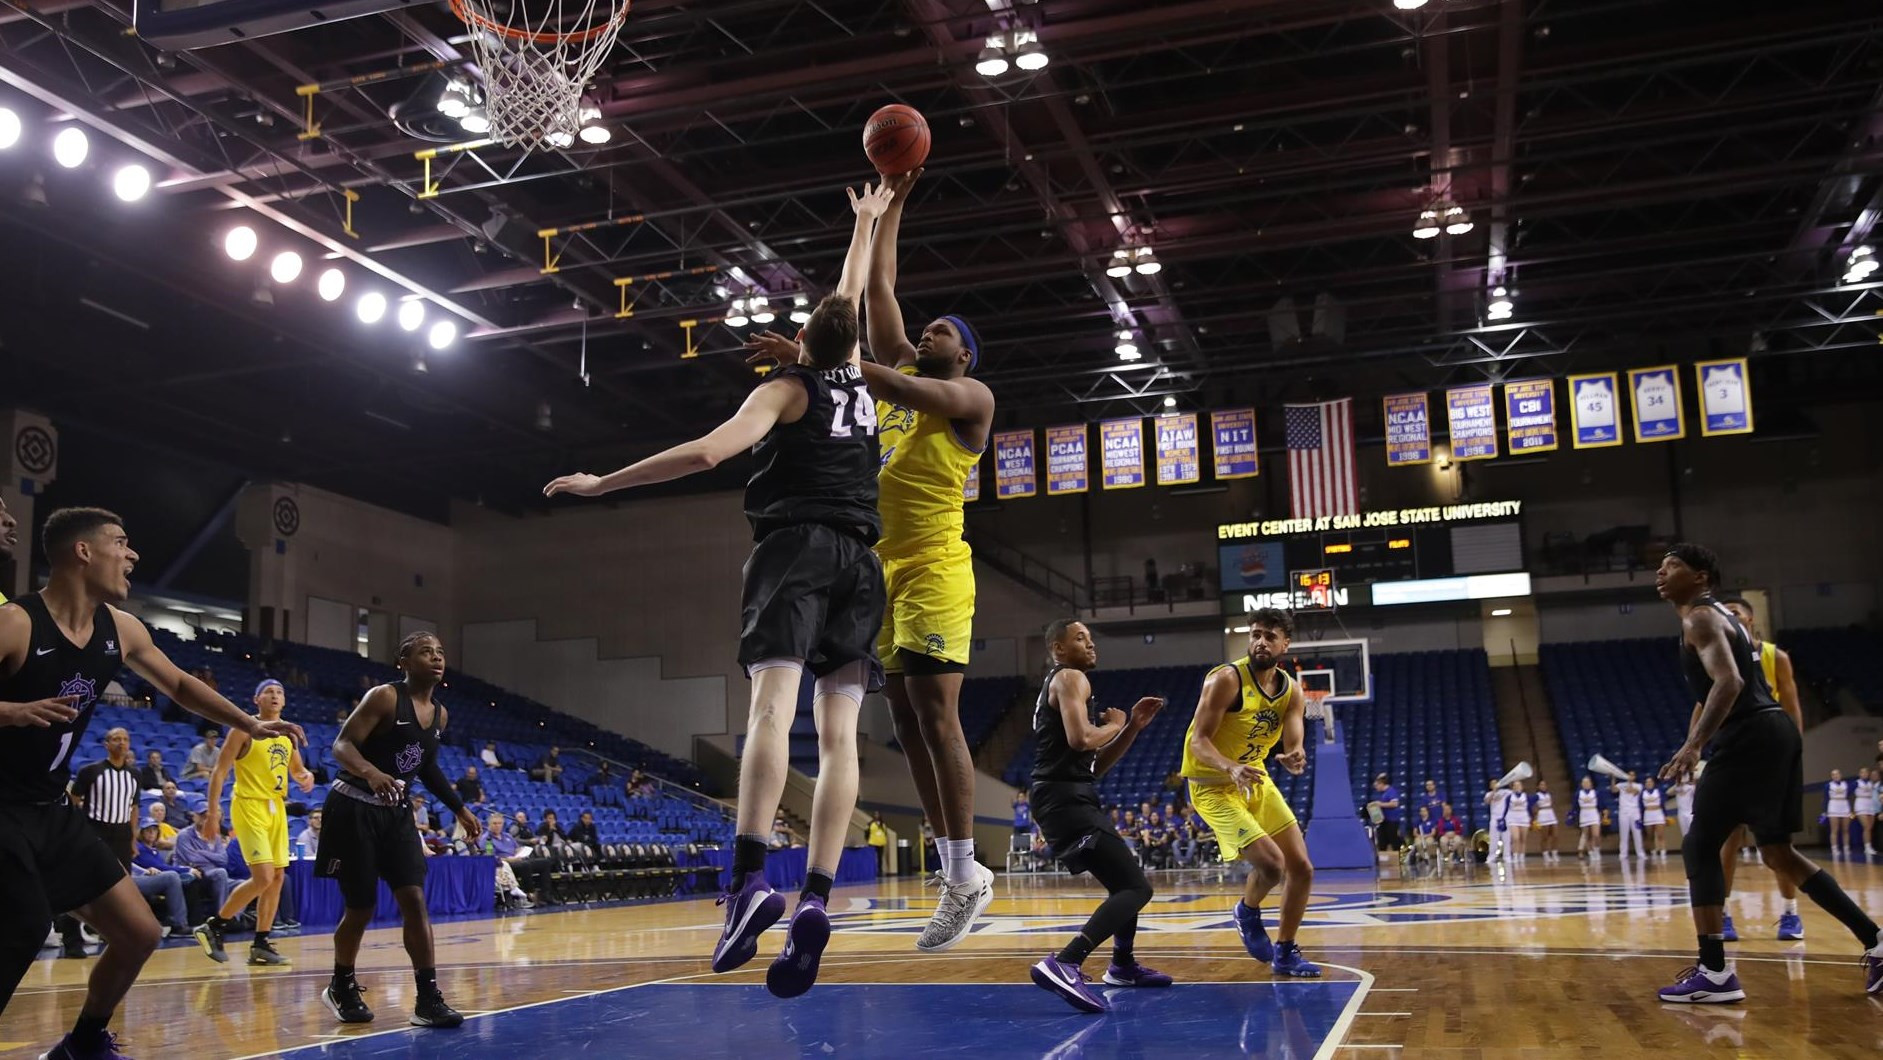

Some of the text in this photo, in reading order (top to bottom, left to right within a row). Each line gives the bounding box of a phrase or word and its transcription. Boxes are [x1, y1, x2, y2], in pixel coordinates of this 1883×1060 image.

[1720, 390, 1728, 398] 3
[1519, 400, 1542, 414] CBI
[1587, 402, 1602, 412] 45
[1647, 396, 1664, 406] 34
[830, 386, 878, 437] 24
[1388, 411, 1425, 424] NCAA
[1450, 404, 1490, 419] BIG WEST
[1451, 418, 1491, 430] TOURNAMENT
[1510, 414, 1552, 428] TOURNAMENT
[1161, 429, 1194, 442] AIAW
[1388, 424, 1426, 435] MID WEST
[1452, 428, 1492, 438] CHAMPIONS
[1106, 436, 1138, 450] NCAA
[1388, 434, 1427, 444] REGIONAL
[1522, 436, 1544, 448] 2011
[998, 446, 1031, 460] NCAA
[1050, 442, 1084, 455] PCAA
[1106, 448, 1138, 458] MIDWEST
[1234, 444, 1254, 453] ROUND
[1004, 460, 1026, 468] WEST
[1050, 463, 1084, 474] CHAMPIONS
[1106, 458, 1140, 468] REGIONAL
[998, 467, 1032, 478] REGIONAL
[1218, 500, 1521, 538] EVENT CENTER AT SAN JOSE STATE UNIVERSITY
[1243, 588, 1348, 612] NISSAN
[50, 732, 73, 772] 1
[274, 776, 284, 792] 2
